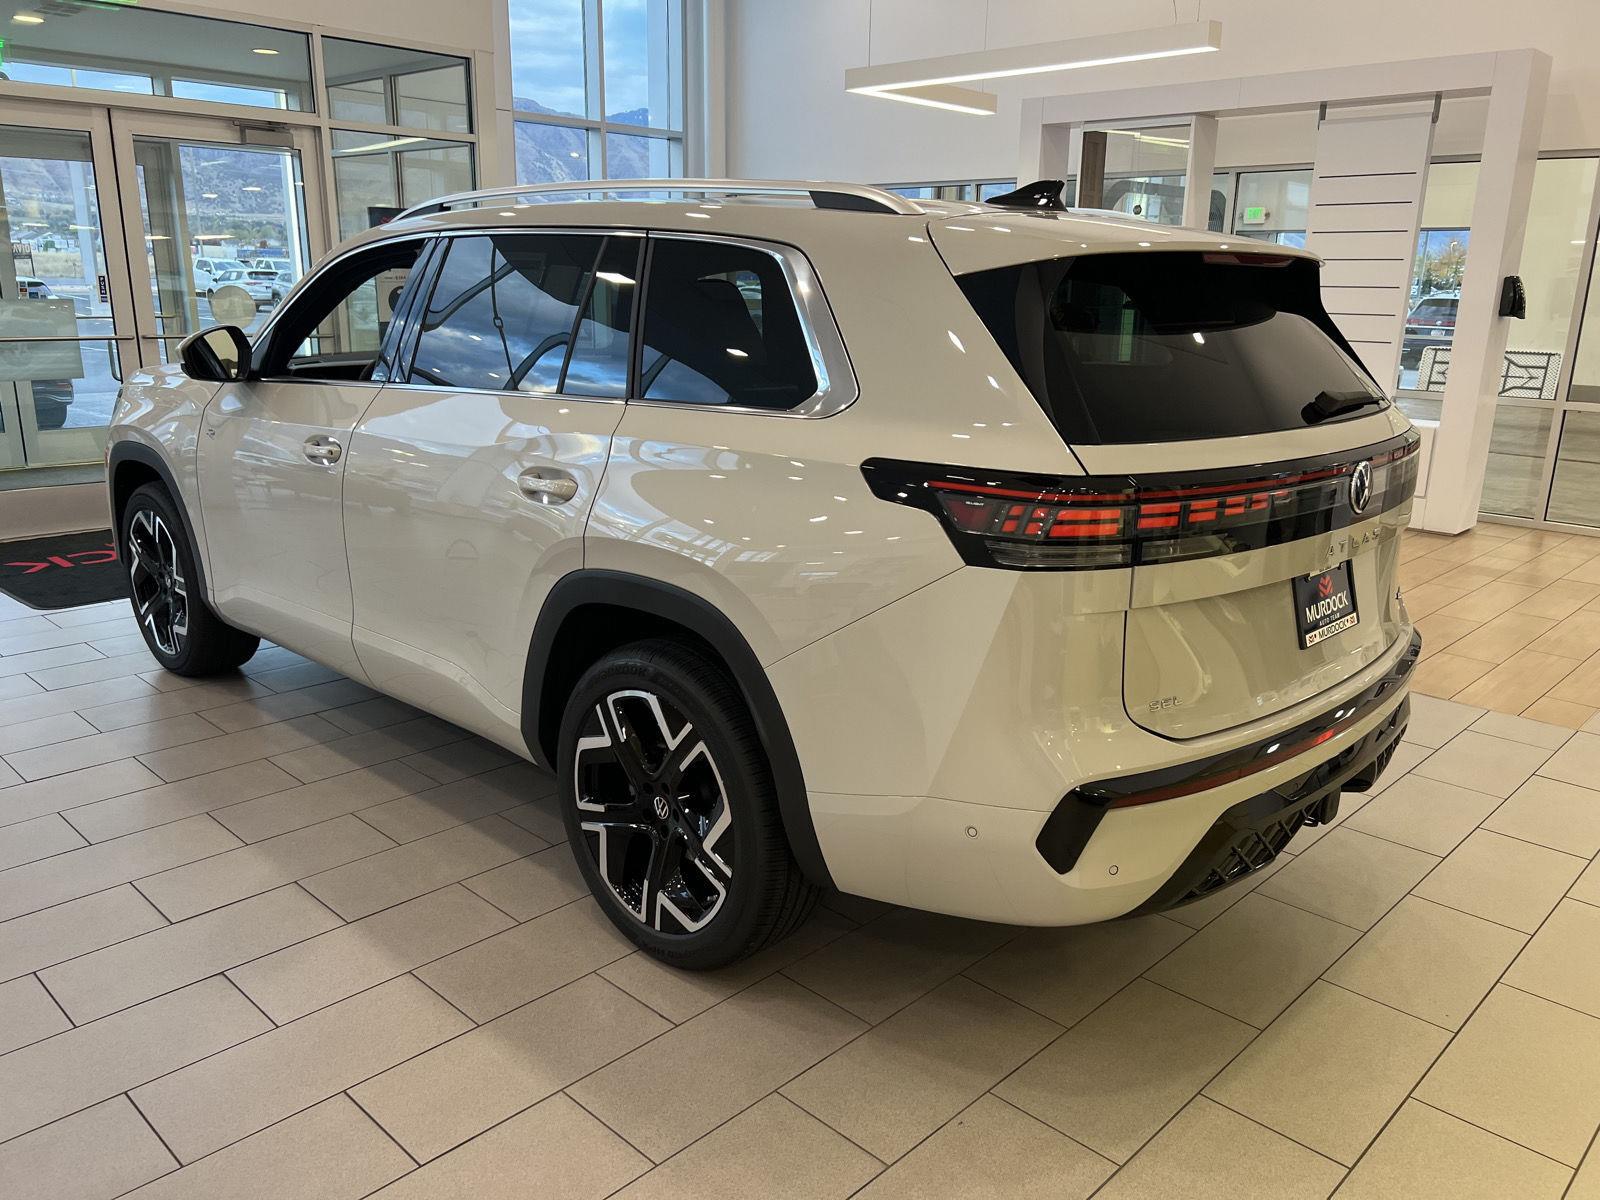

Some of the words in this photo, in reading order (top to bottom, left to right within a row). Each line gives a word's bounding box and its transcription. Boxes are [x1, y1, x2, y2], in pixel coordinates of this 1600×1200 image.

[1325, 527, 1380, 560] ATLAS
[1305, 591, 1348, 623] MURDOCK
[1318, 618, 1347, 639] MURDOCK
[1319, 617, 1330, 626] AUTO
[1330, 613, 1340, 621] TEAM
[1149, 696, 1183, 712] SEL
